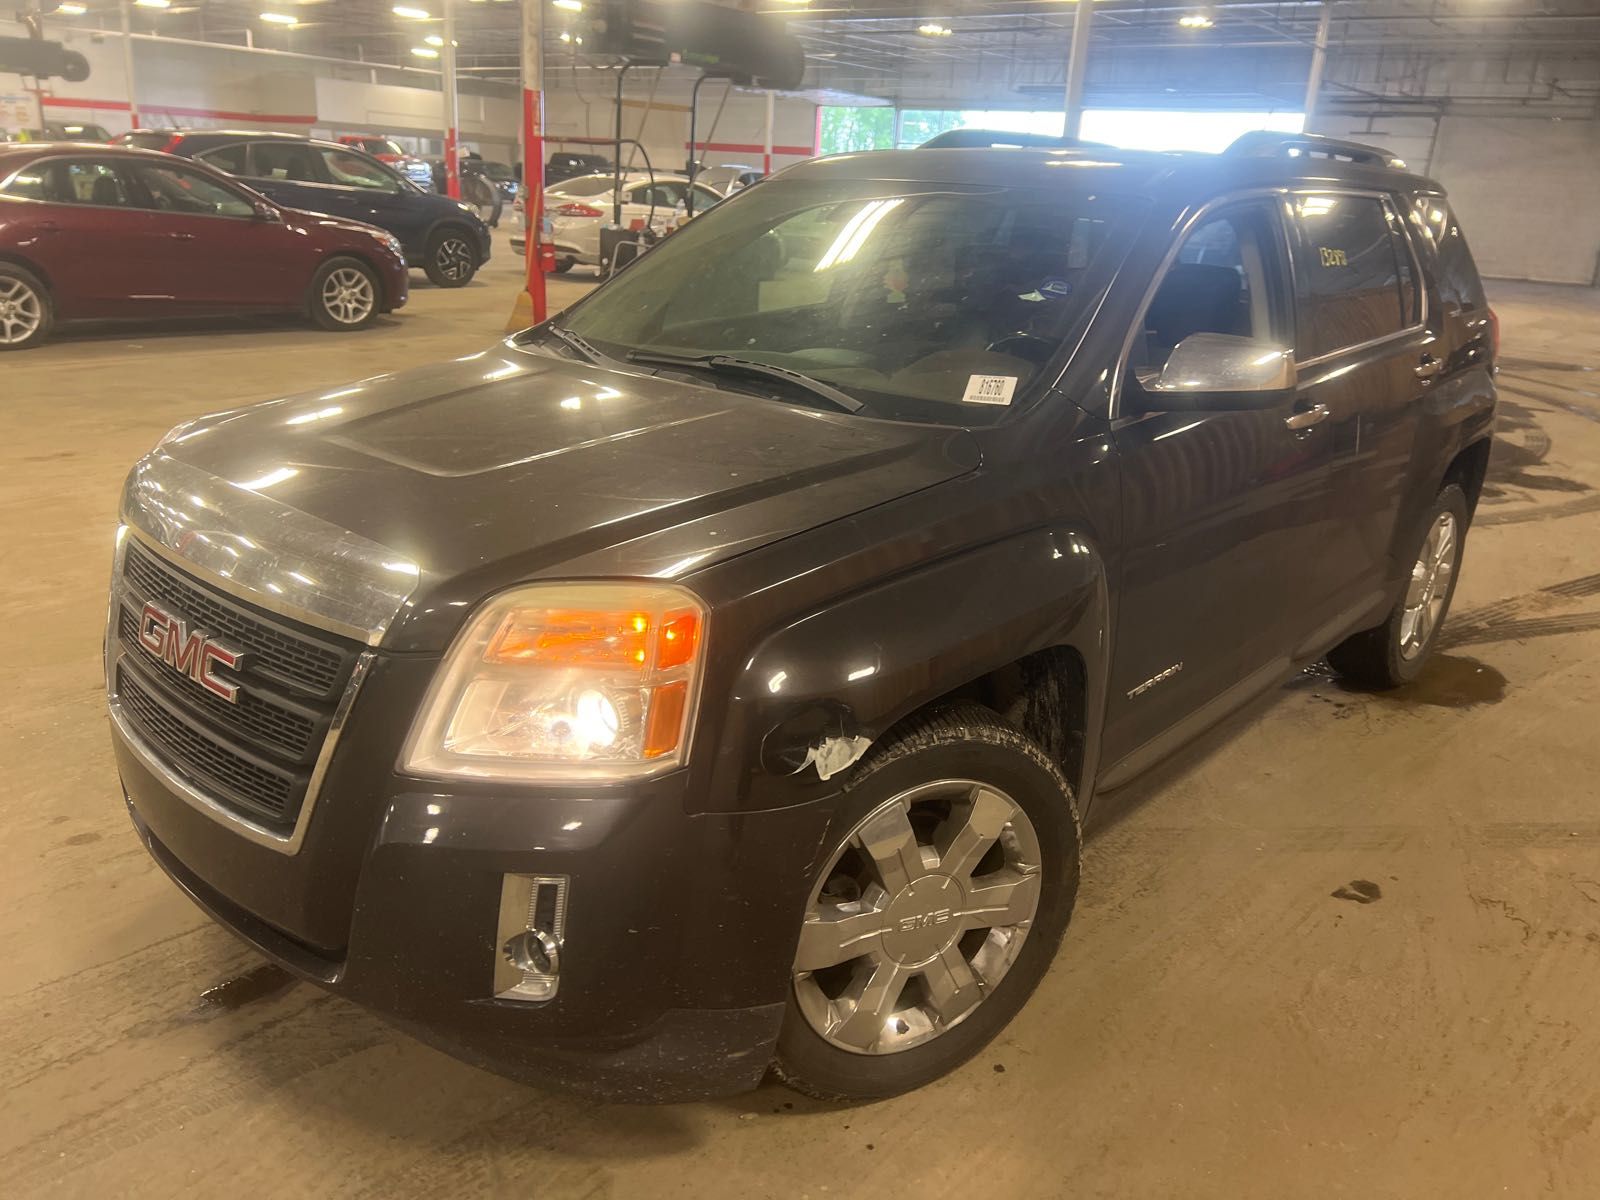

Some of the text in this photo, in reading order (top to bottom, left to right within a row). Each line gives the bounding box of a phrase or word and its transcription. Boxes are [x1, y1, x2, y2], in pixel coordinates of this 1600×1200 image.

[138, 600, 244, 705] GMC
[1126, 661, 1184, 700] TERRAIN
[899, 908, 950, 932] GMC
